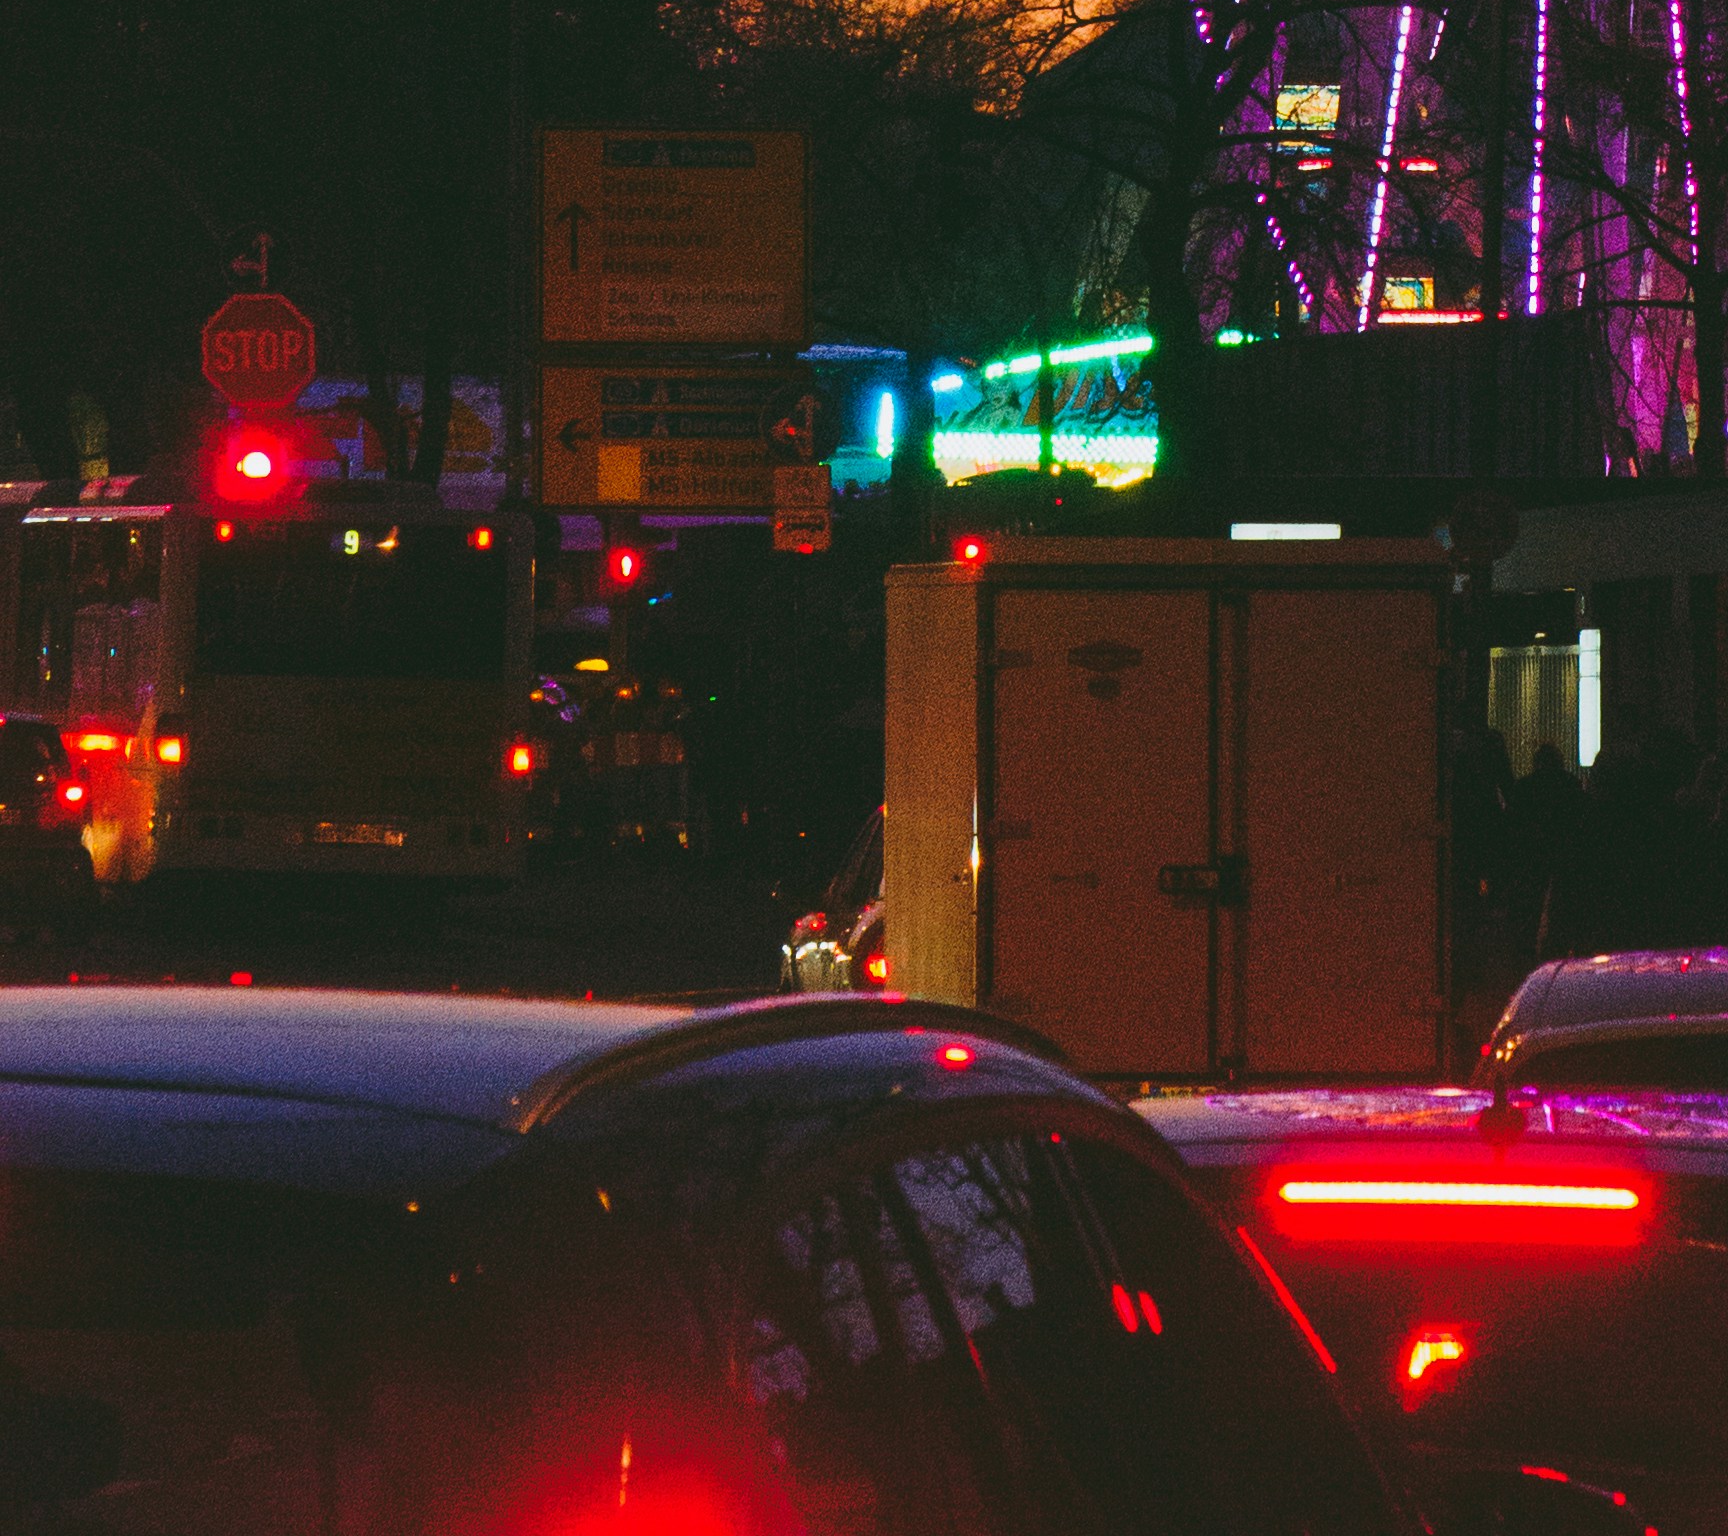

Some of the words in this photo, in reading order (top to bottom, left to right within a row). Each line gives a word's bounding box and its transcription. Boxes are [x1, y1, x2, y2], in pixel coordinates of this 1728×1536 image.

[214, 329, 304, 373] STOP
[679, 417, 758, 433] Dortmun
[344, 529, 360, 556] 9
